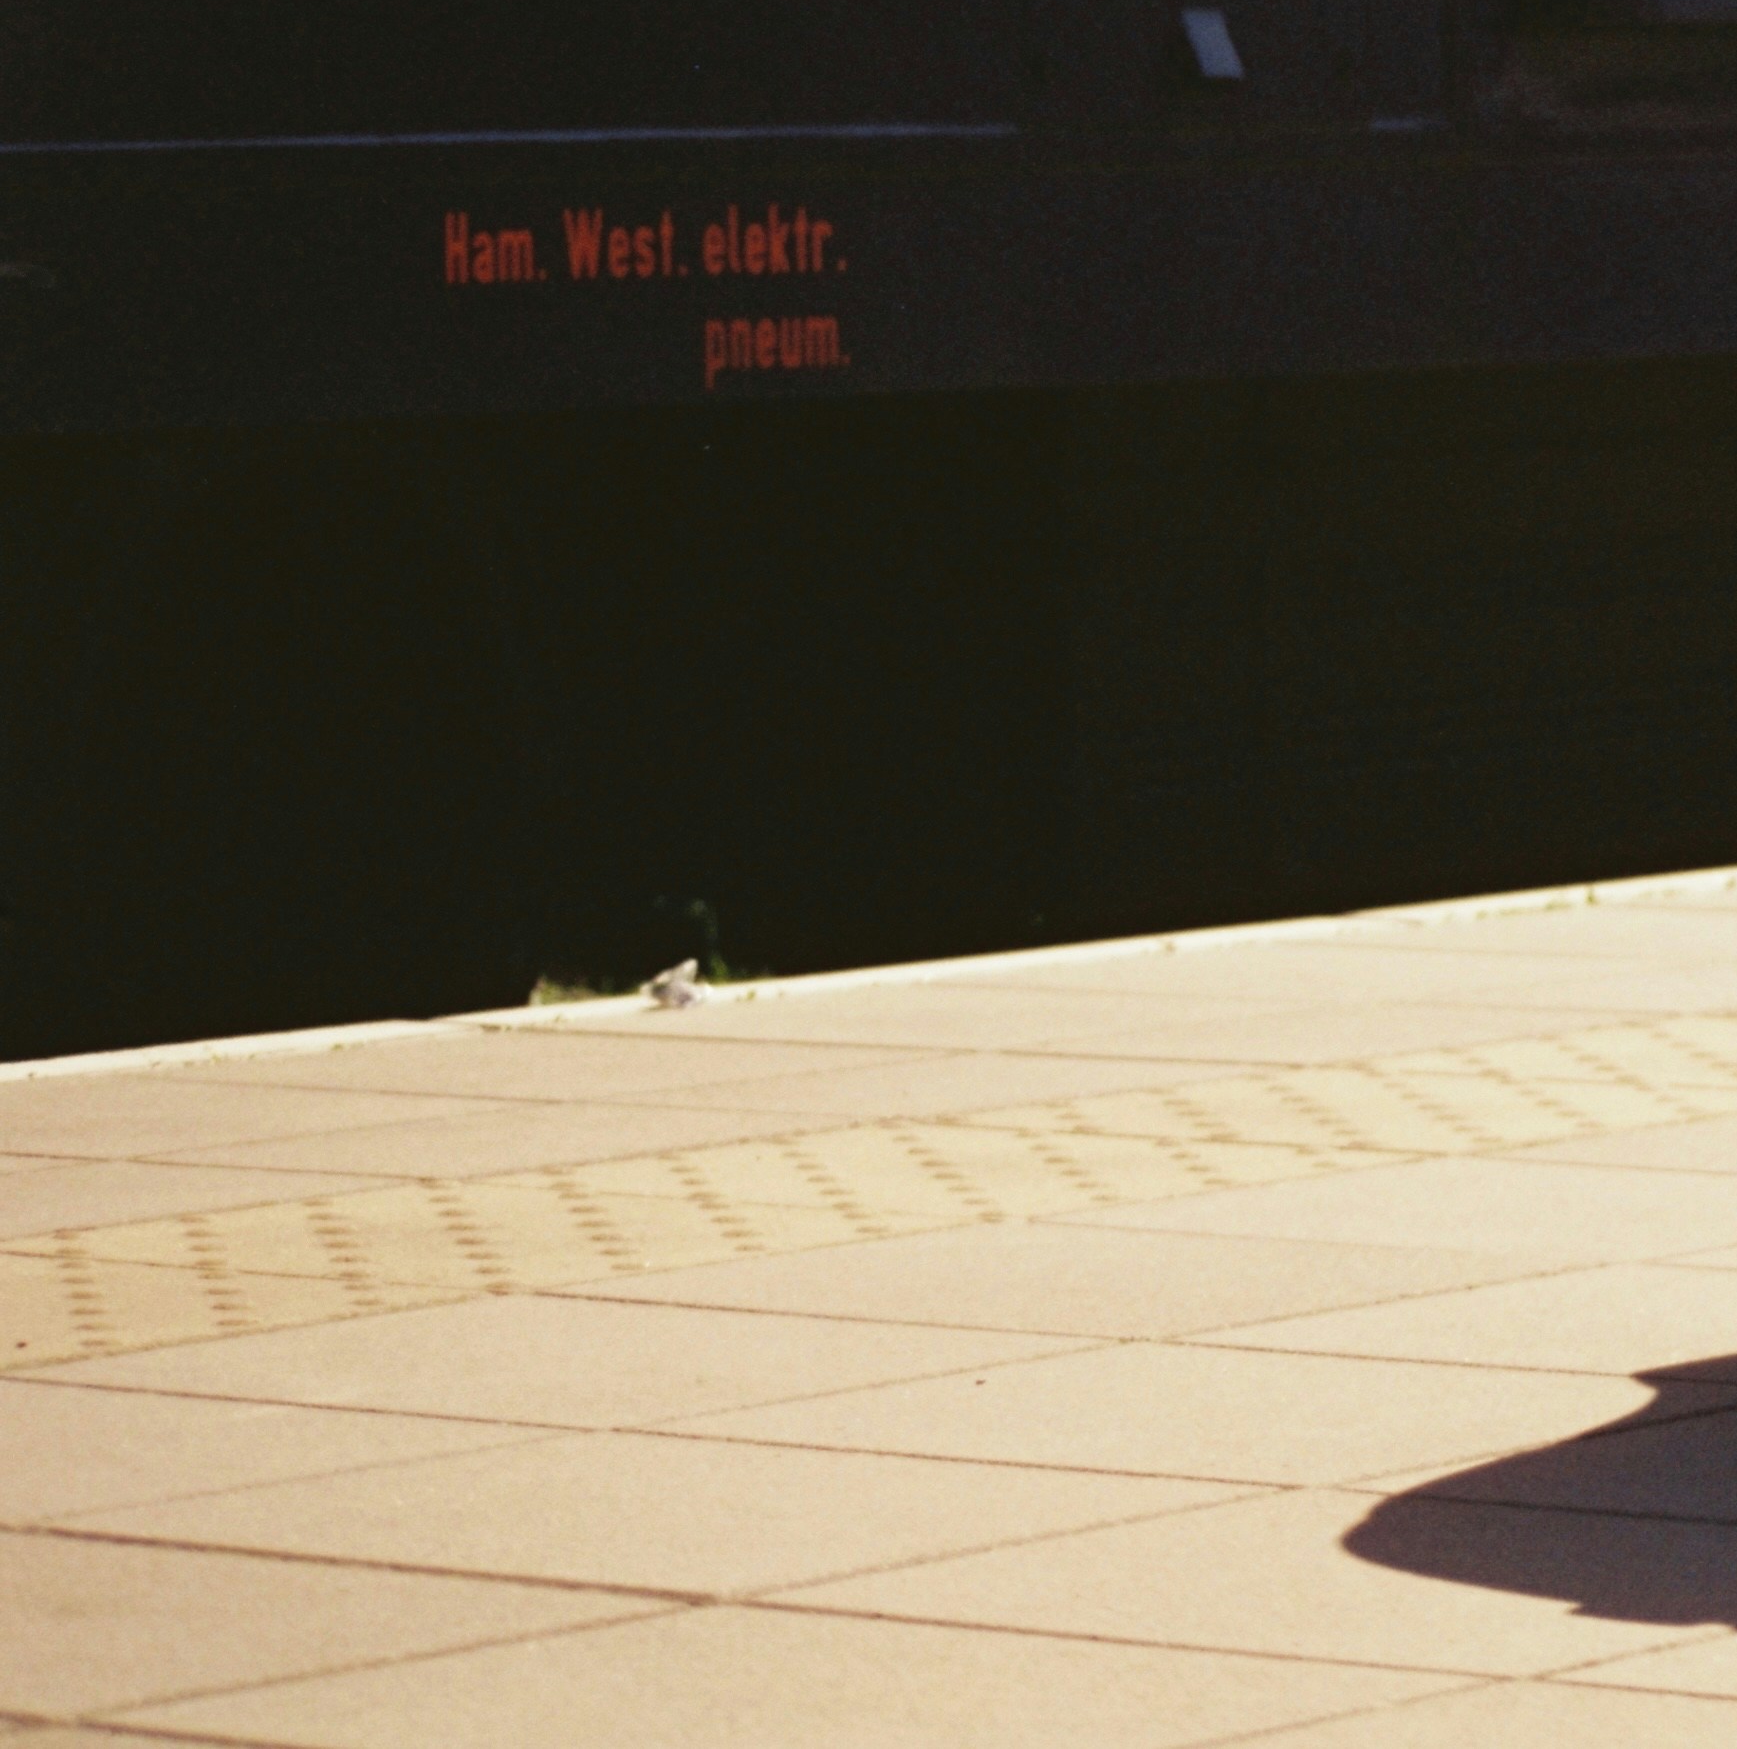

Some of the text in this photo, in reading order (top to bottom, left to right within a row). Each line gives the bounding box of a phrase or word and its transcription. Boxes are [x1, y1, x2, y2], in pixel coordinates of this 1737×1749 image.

[444, 210, 549, 285] Ham.
[702, 202, 848, 276] elektr.
[704, 314, 852, 391] pneum.
